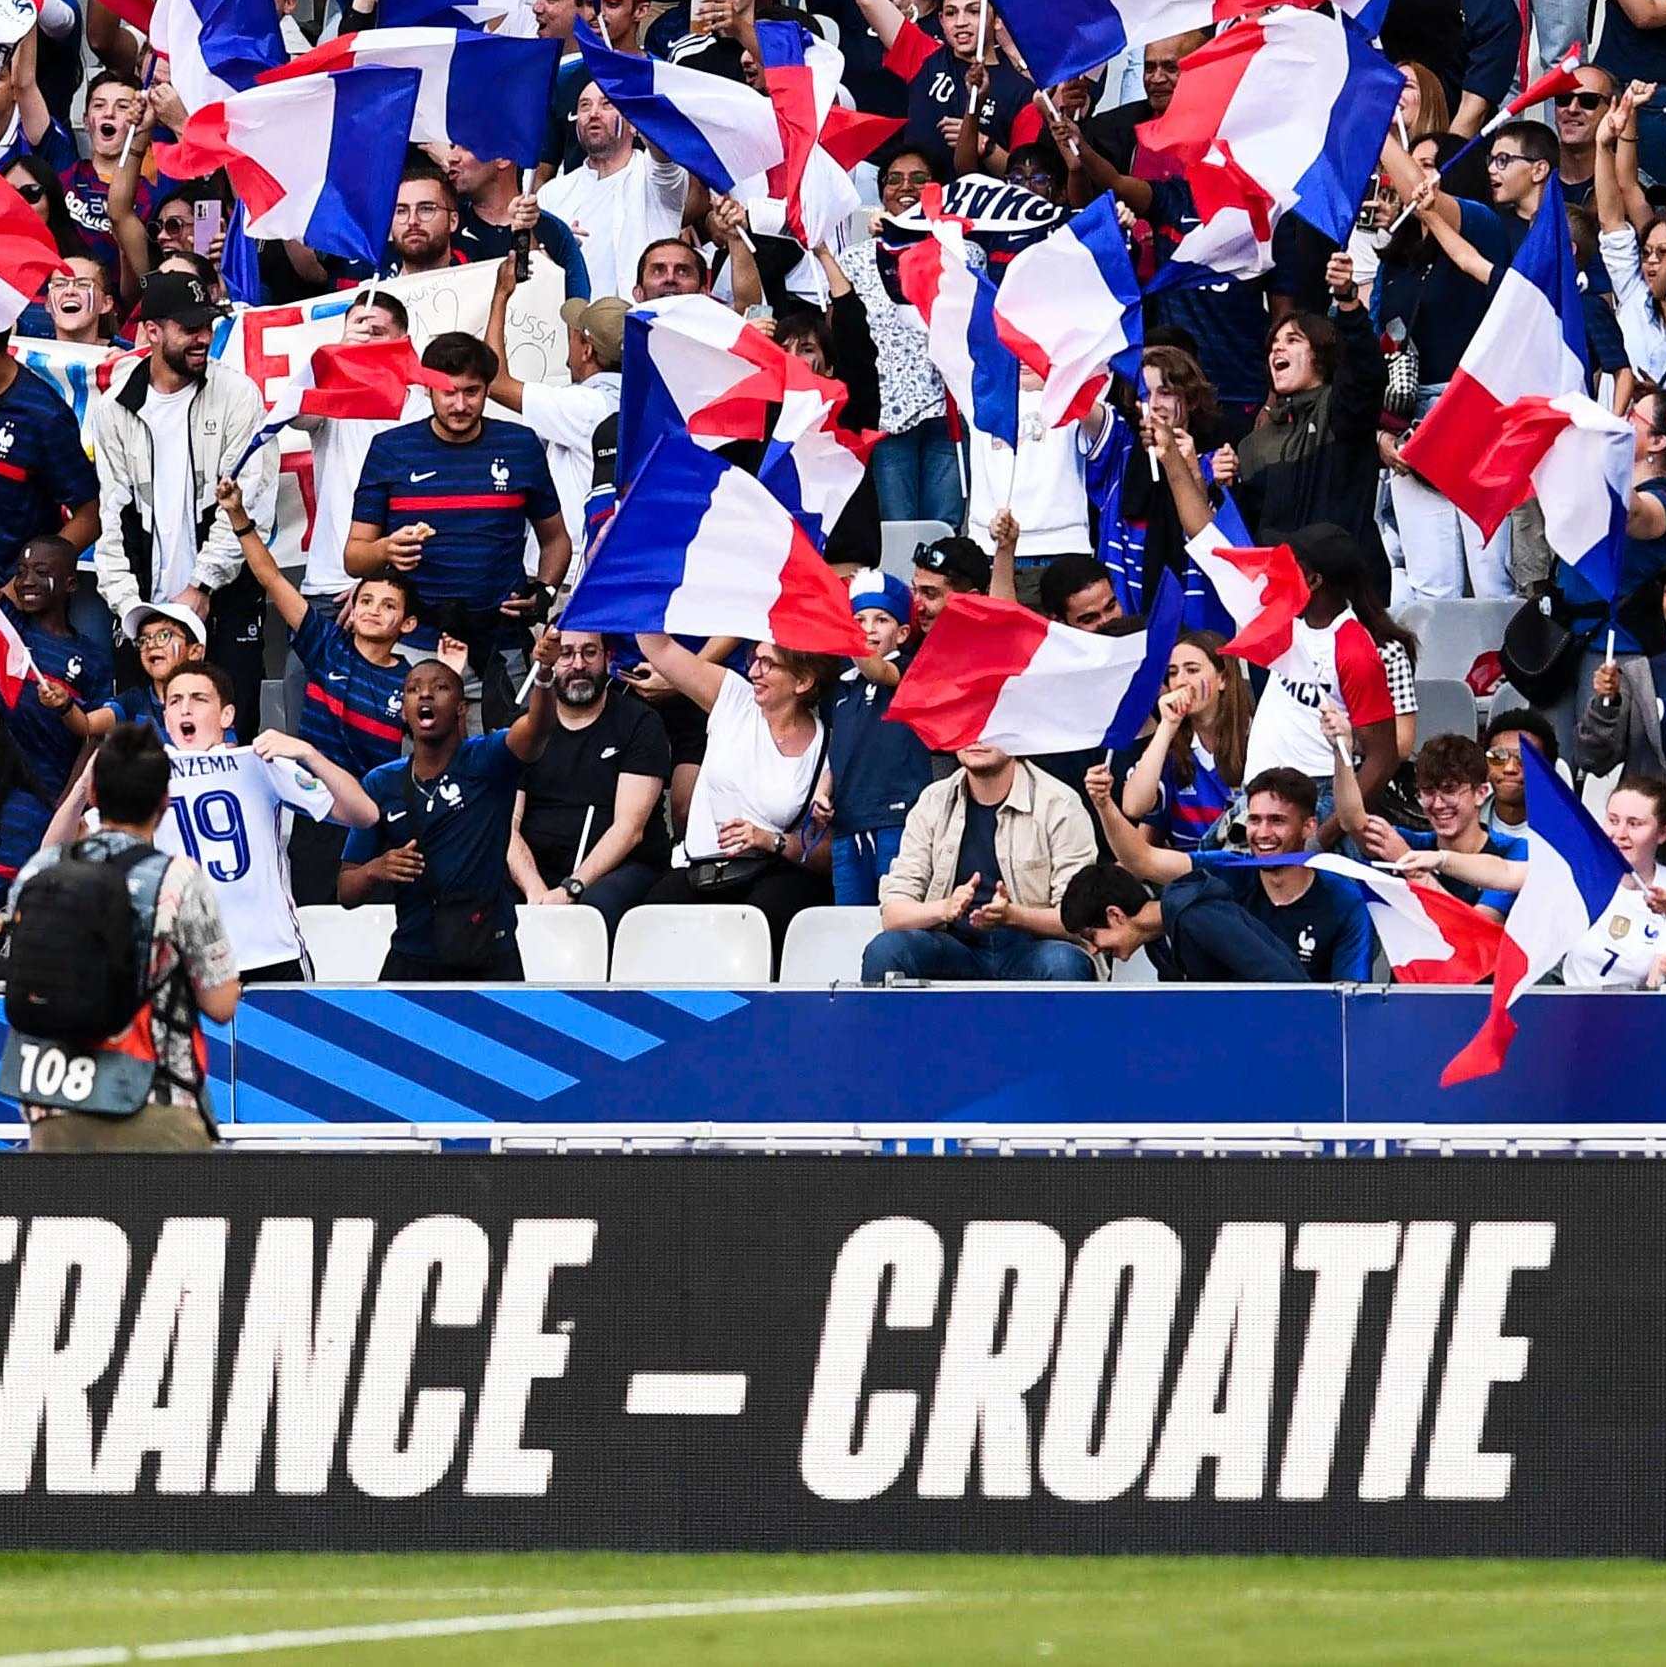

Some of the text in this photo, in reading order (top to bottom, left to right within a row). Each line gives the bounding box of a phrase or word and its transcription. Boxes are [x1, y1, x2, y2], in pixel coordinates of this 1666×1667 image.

[929, 72, 956, 103] 10
[64, 190, 113, 233] Rakute
[169, 788, 252, 883] 19
[1599, 947, 1620, 978] 7
[20, 1043, 97, 1103] 108
[798, 1215, 1557, 1502] CROATIE
